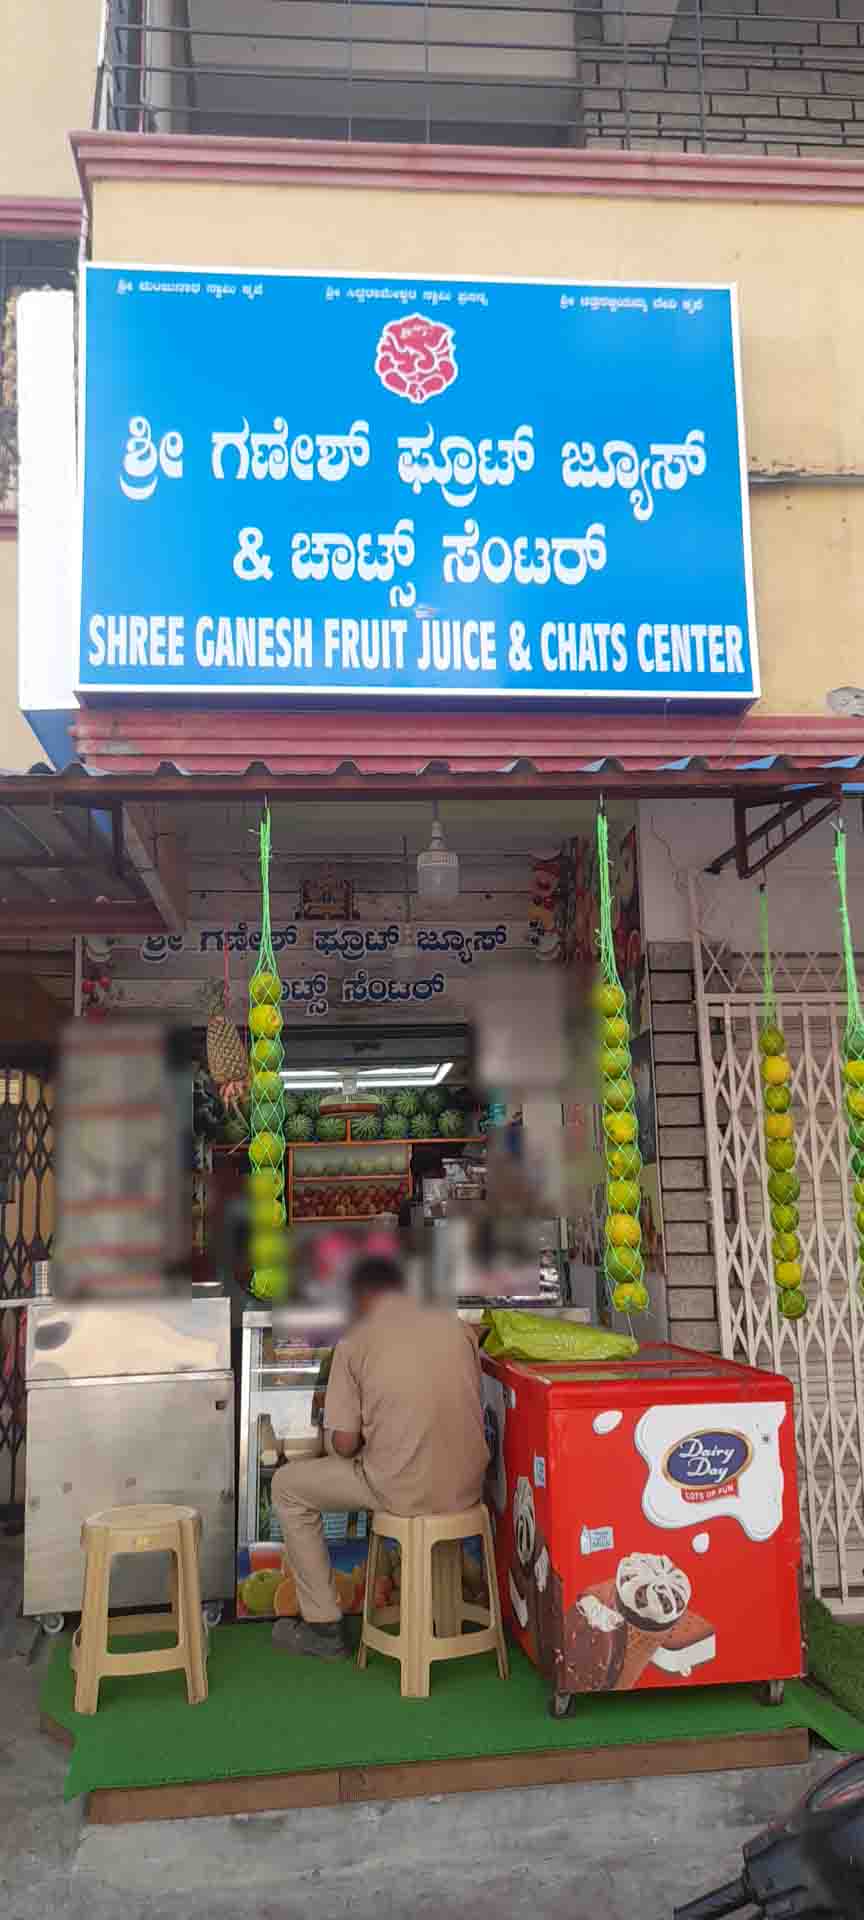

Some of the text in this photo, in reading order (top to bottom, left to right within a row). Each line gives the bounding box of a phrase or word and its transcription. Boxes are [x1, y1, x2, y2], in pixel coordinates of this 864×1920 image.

[120, 416, 706, 521] ಶ್ರೀ ಗಣೇಶ್ ಫ್ರೂಟ್ ಜ್ಯೂಸ್
[233, 519, 607, 608] & ಚಾಟ್ಸ್ ಸೆಂಟರ್
[88, 614, 744, 673] SHREE GANESH FRUIT JUICE & CHATS CENTER
[415, 924, 508, 964] ಜ್ಯೂಸ್
[343, 970, 444, 1001] ಸೆಂಟರ್
[679, 1438, 736, 1465] Dairy
[687, 1456, 729, 1483] Day
